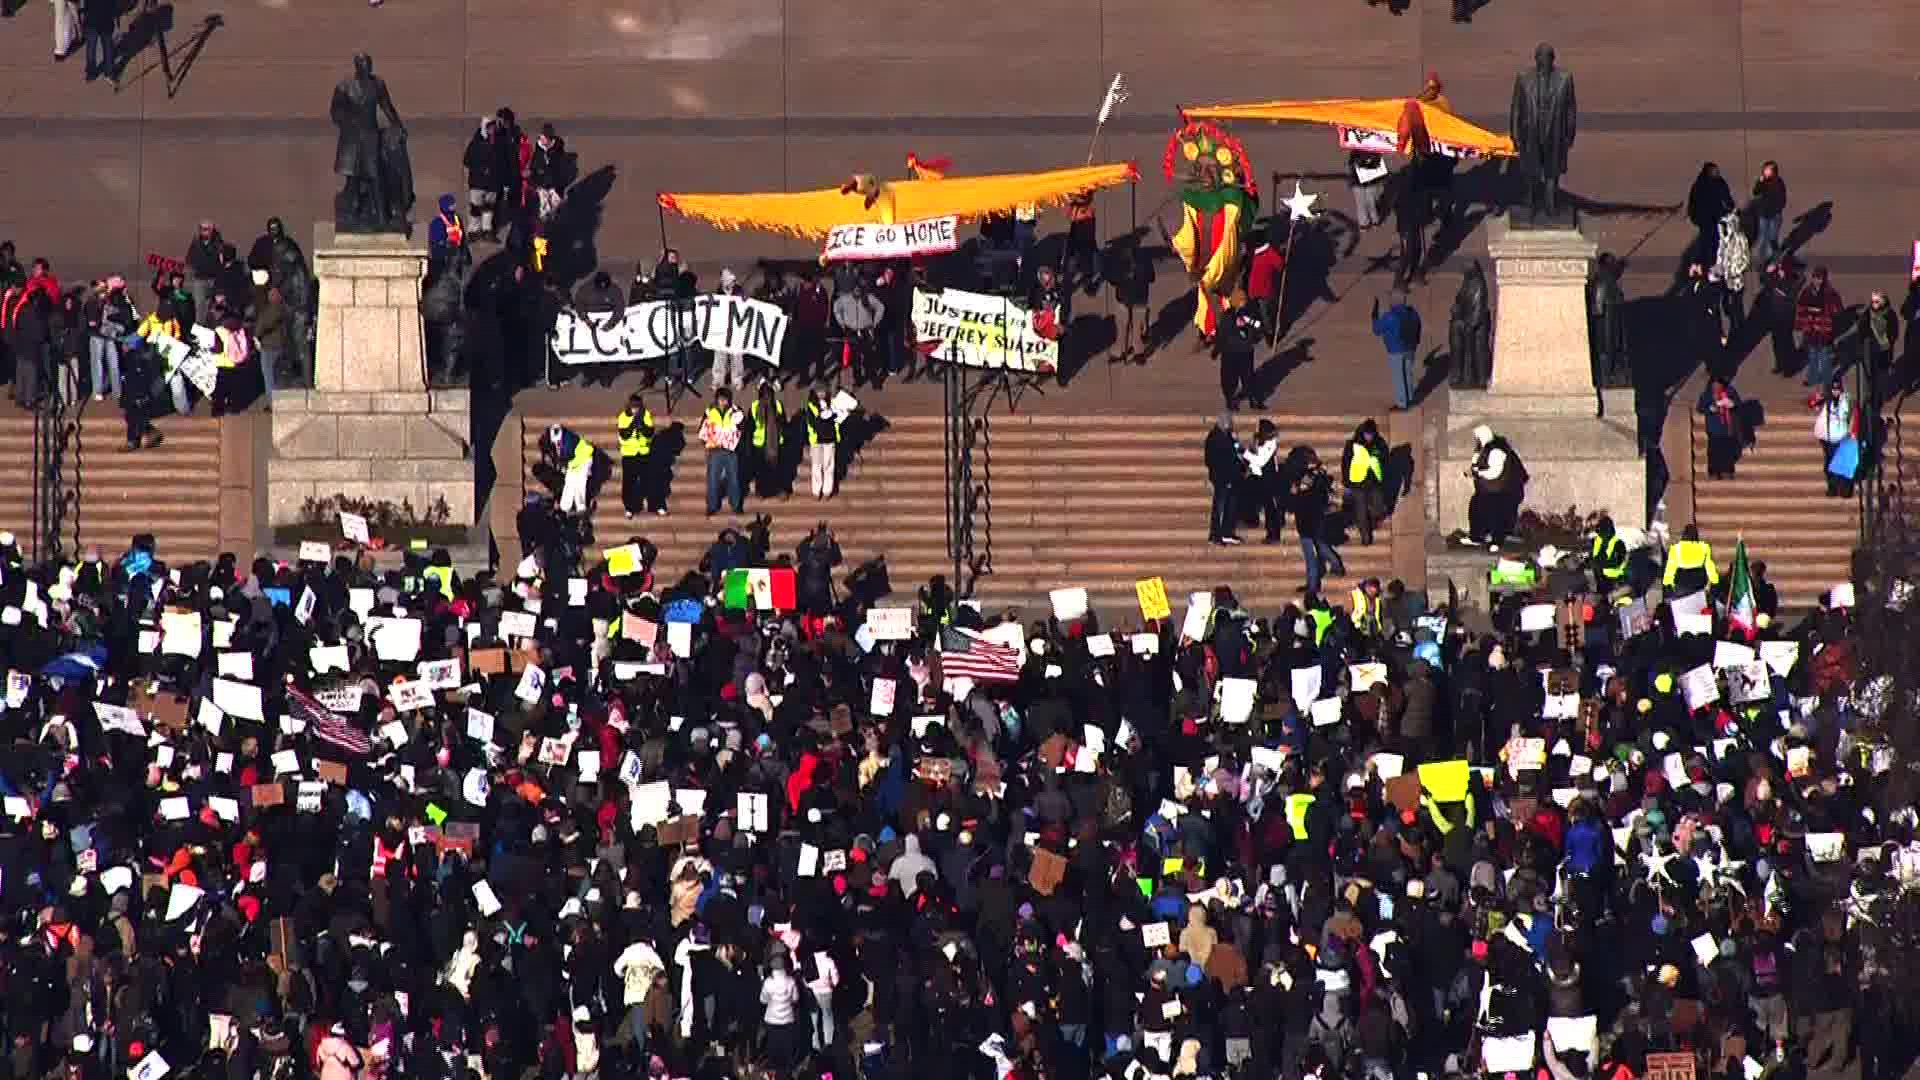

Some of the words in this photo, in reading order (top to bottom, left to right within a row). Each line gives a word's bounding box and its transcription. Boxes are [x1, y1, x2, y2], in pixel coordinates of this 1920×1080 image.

[829, 226, 865, 250] ICE
[875, 228, 896, 244] GO
[904, 220, 951, 246] HOME
[648, 300, 720, 350] OUT
[725, 300, 781, 356] MN
[924, 297, 1005, 328] JUSTICE
[920, 320, 988, 345] JEFFREY
[991, 334, 1046, 353] SUAZO
